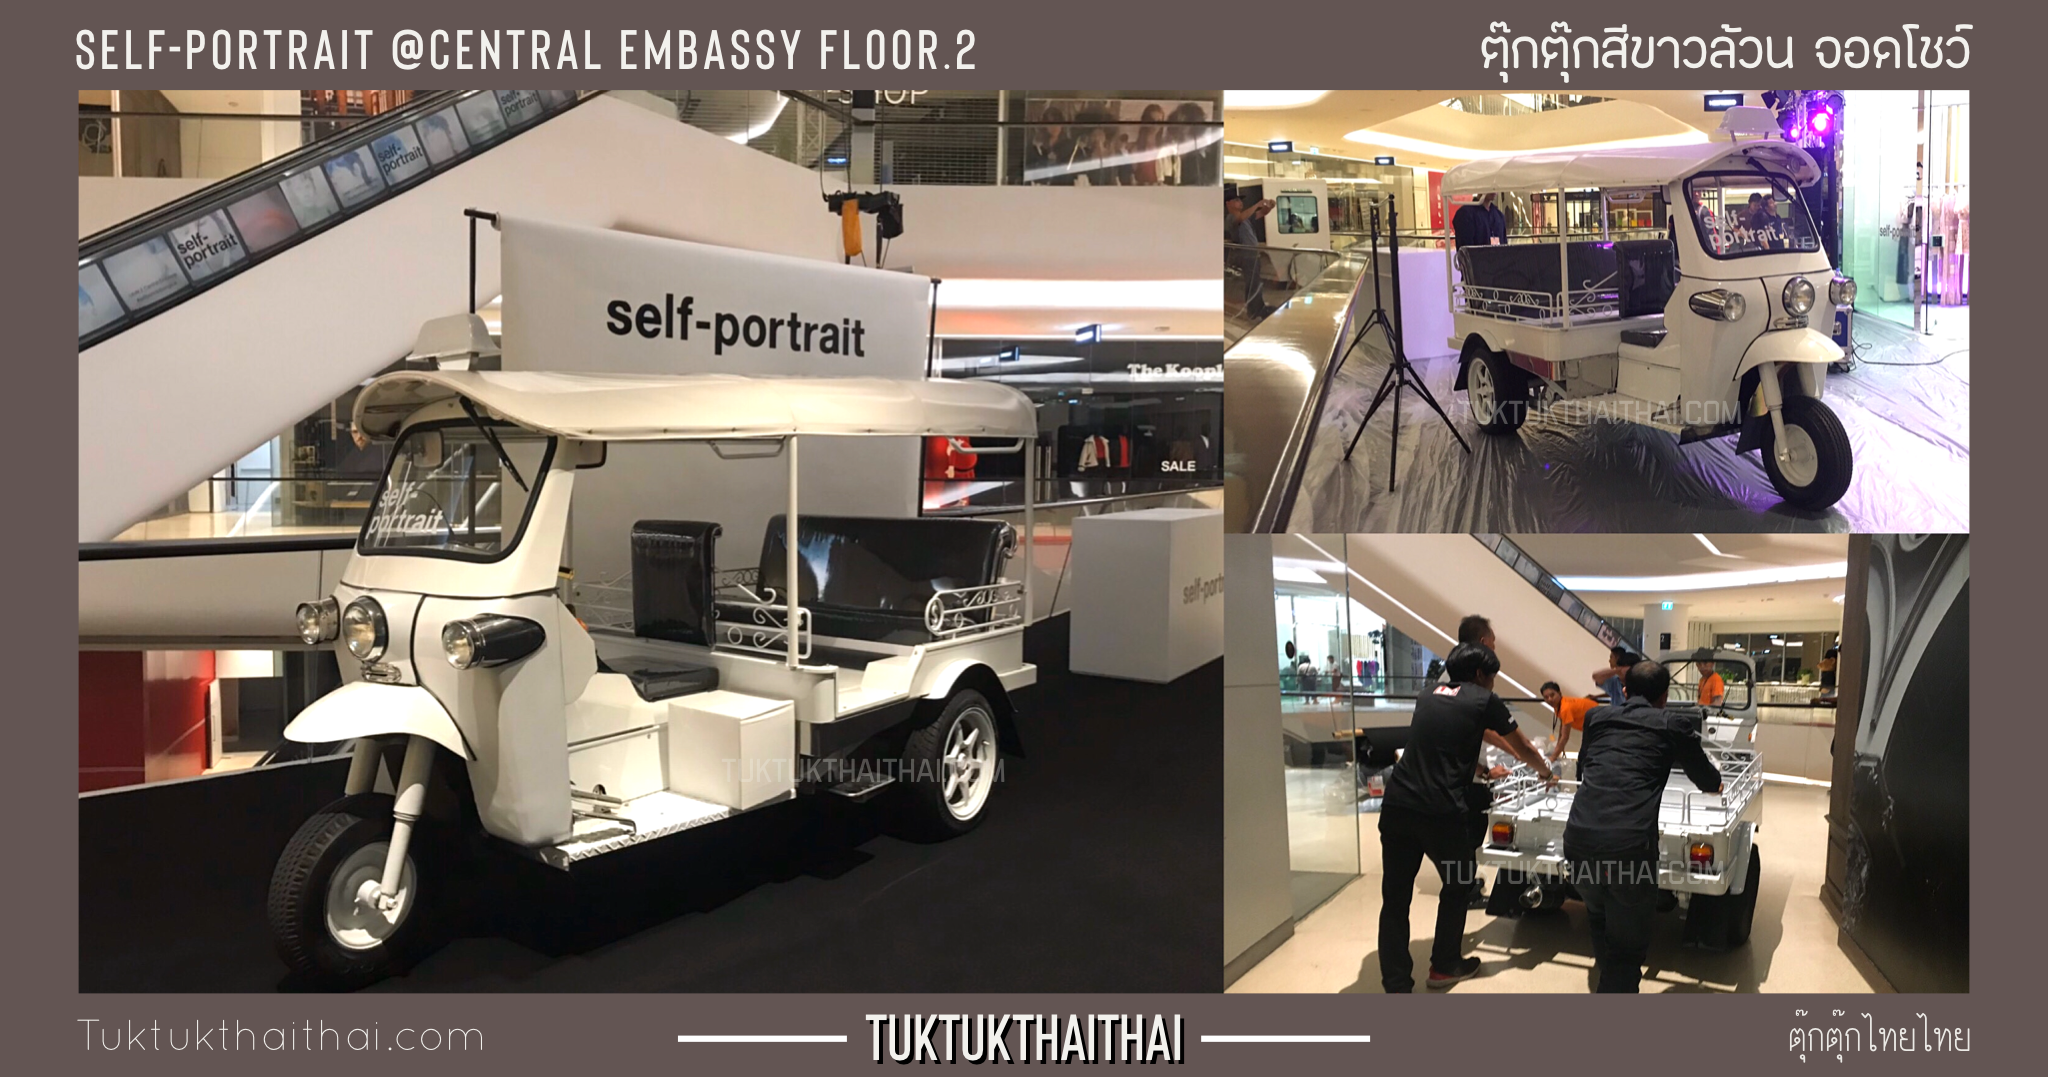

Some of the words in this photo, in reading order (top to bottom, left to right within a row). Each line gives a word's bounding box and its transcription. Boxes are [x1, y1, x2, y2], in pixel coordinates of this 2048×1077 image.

[504, 92, 539, 117] portrait
[378, 143, 402, 163] self-
[383, 146, 424, 176] portrait
[1704, 210, 1746, 229] self-
[177, 232, 209, 255] self-
[1708, 224, 1779, 251] portrait
[184, 233, 238, 270] portrait
[606, 293, 865, 358] self-portrait
[1127, 363, 1163, 377] The
[1165, 363, 1224, 381] Koopl
[1161, 460, 1196, 473] SALE
[379, 481, 418, 508] self-
[365, 508, 444, 540] portrait
